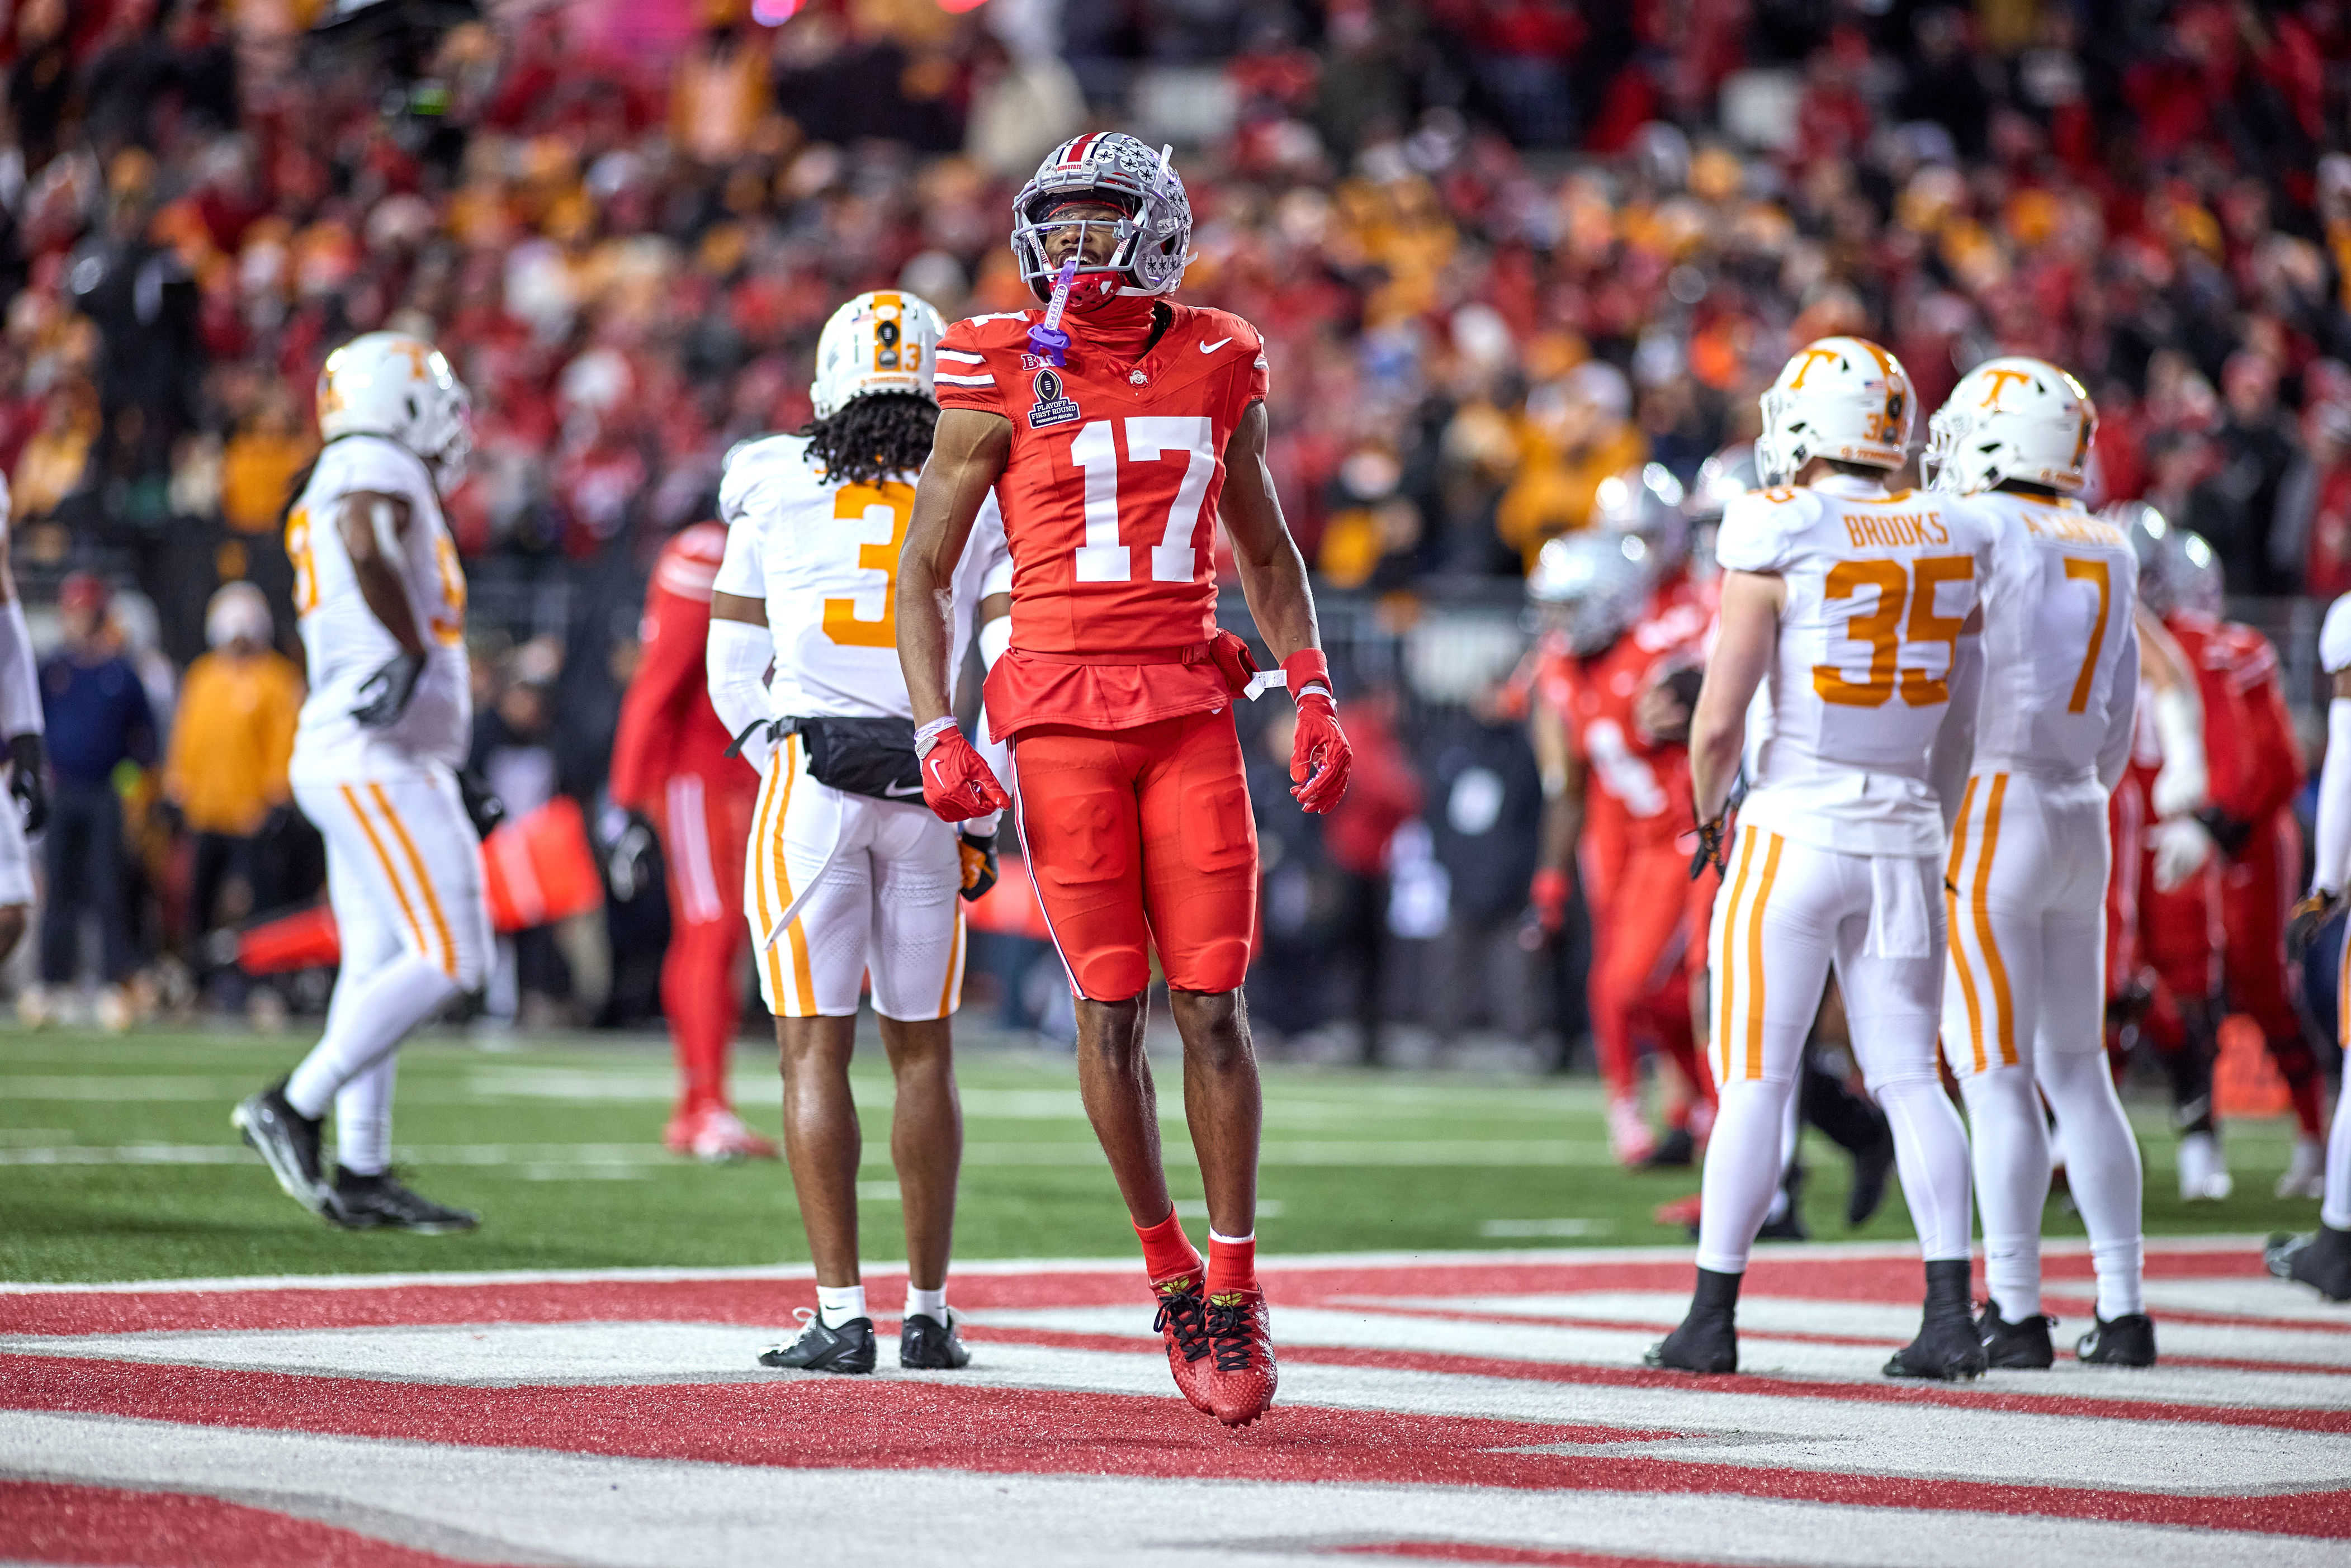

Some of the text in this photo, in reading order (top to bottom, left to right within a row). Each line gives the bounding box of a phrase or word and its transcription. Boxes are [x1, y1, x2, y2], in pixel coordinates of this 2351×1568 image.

[905, 343, 921, 372] 3
[1031, 405, 1076, 420] FIRST ROUND
[1037, 400, 1067, 411] PLAYOFF
[1071, 416, 1215, 582] 17
[1843, 511, 1950, 549] BROOKS
[823, 480, 916, 647] 3
[1812, 555, 1974, 708] 35
[2063, 557, 2111, 714] 7
